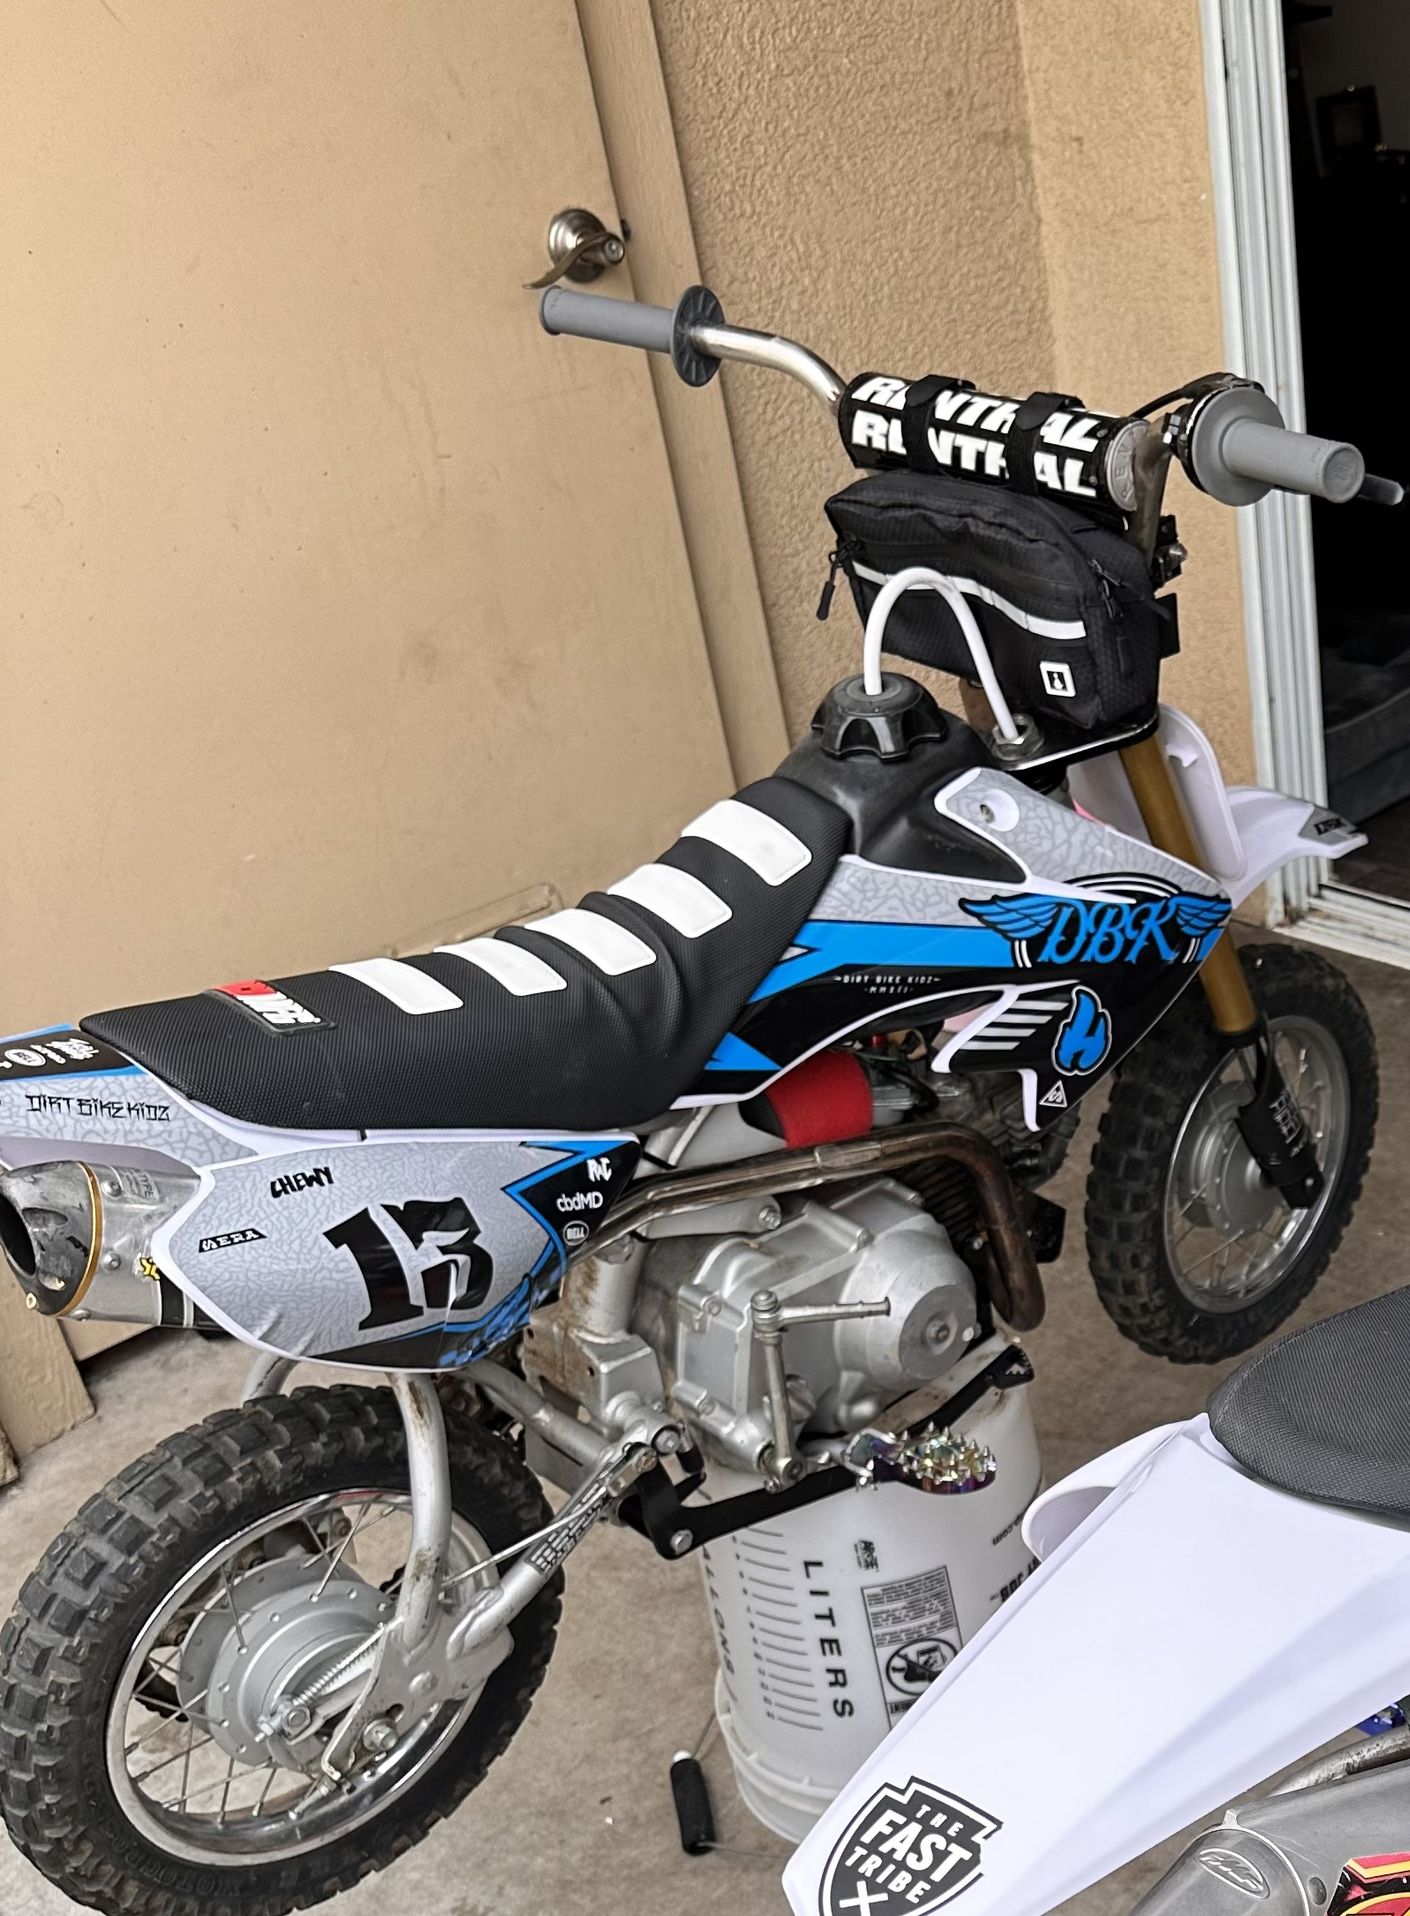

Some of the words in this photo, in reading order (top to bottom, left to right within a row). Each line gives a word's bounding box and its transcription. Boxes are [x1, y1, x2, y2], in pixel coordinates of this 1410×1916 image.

[1038, 899, 1180, 964] DBK
[556, 1190, 604, 1212] cbdMD
[803, 1560, 855, 1719] LITERS
[860, 1809, 973, 1883] FAST
[915, 1804, 964, 1837] THE
[845, 1845, 932, 1904] TRIBE
